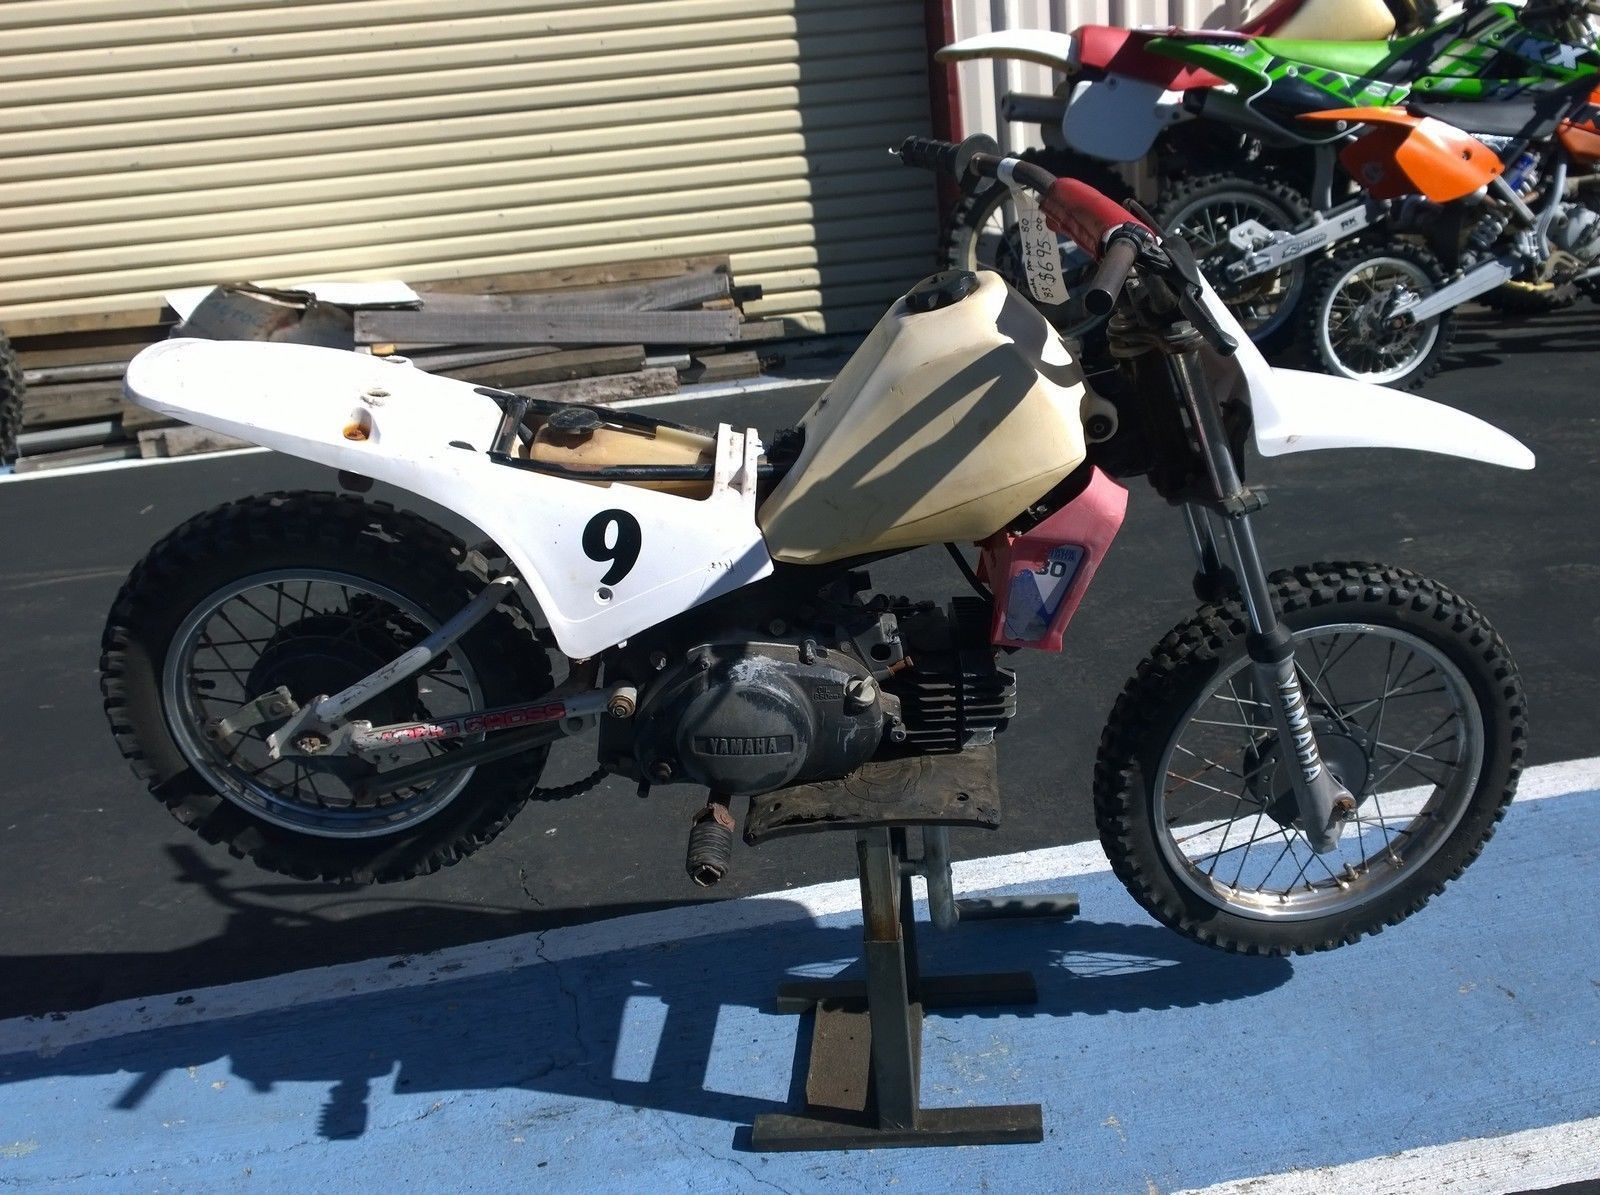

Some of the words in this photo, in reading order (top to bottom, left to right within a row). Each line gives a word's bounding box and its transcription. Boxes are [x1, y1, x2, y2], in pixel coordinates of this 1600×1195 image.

[1516, 39, 1589, 70] KX
[1021, 218, 1030, 233] 80
[582, 508, 642, 587] 9
[1278, 671, 1322, 783] YAMAHA
[708, 737, 778, 754] YAMAHA
